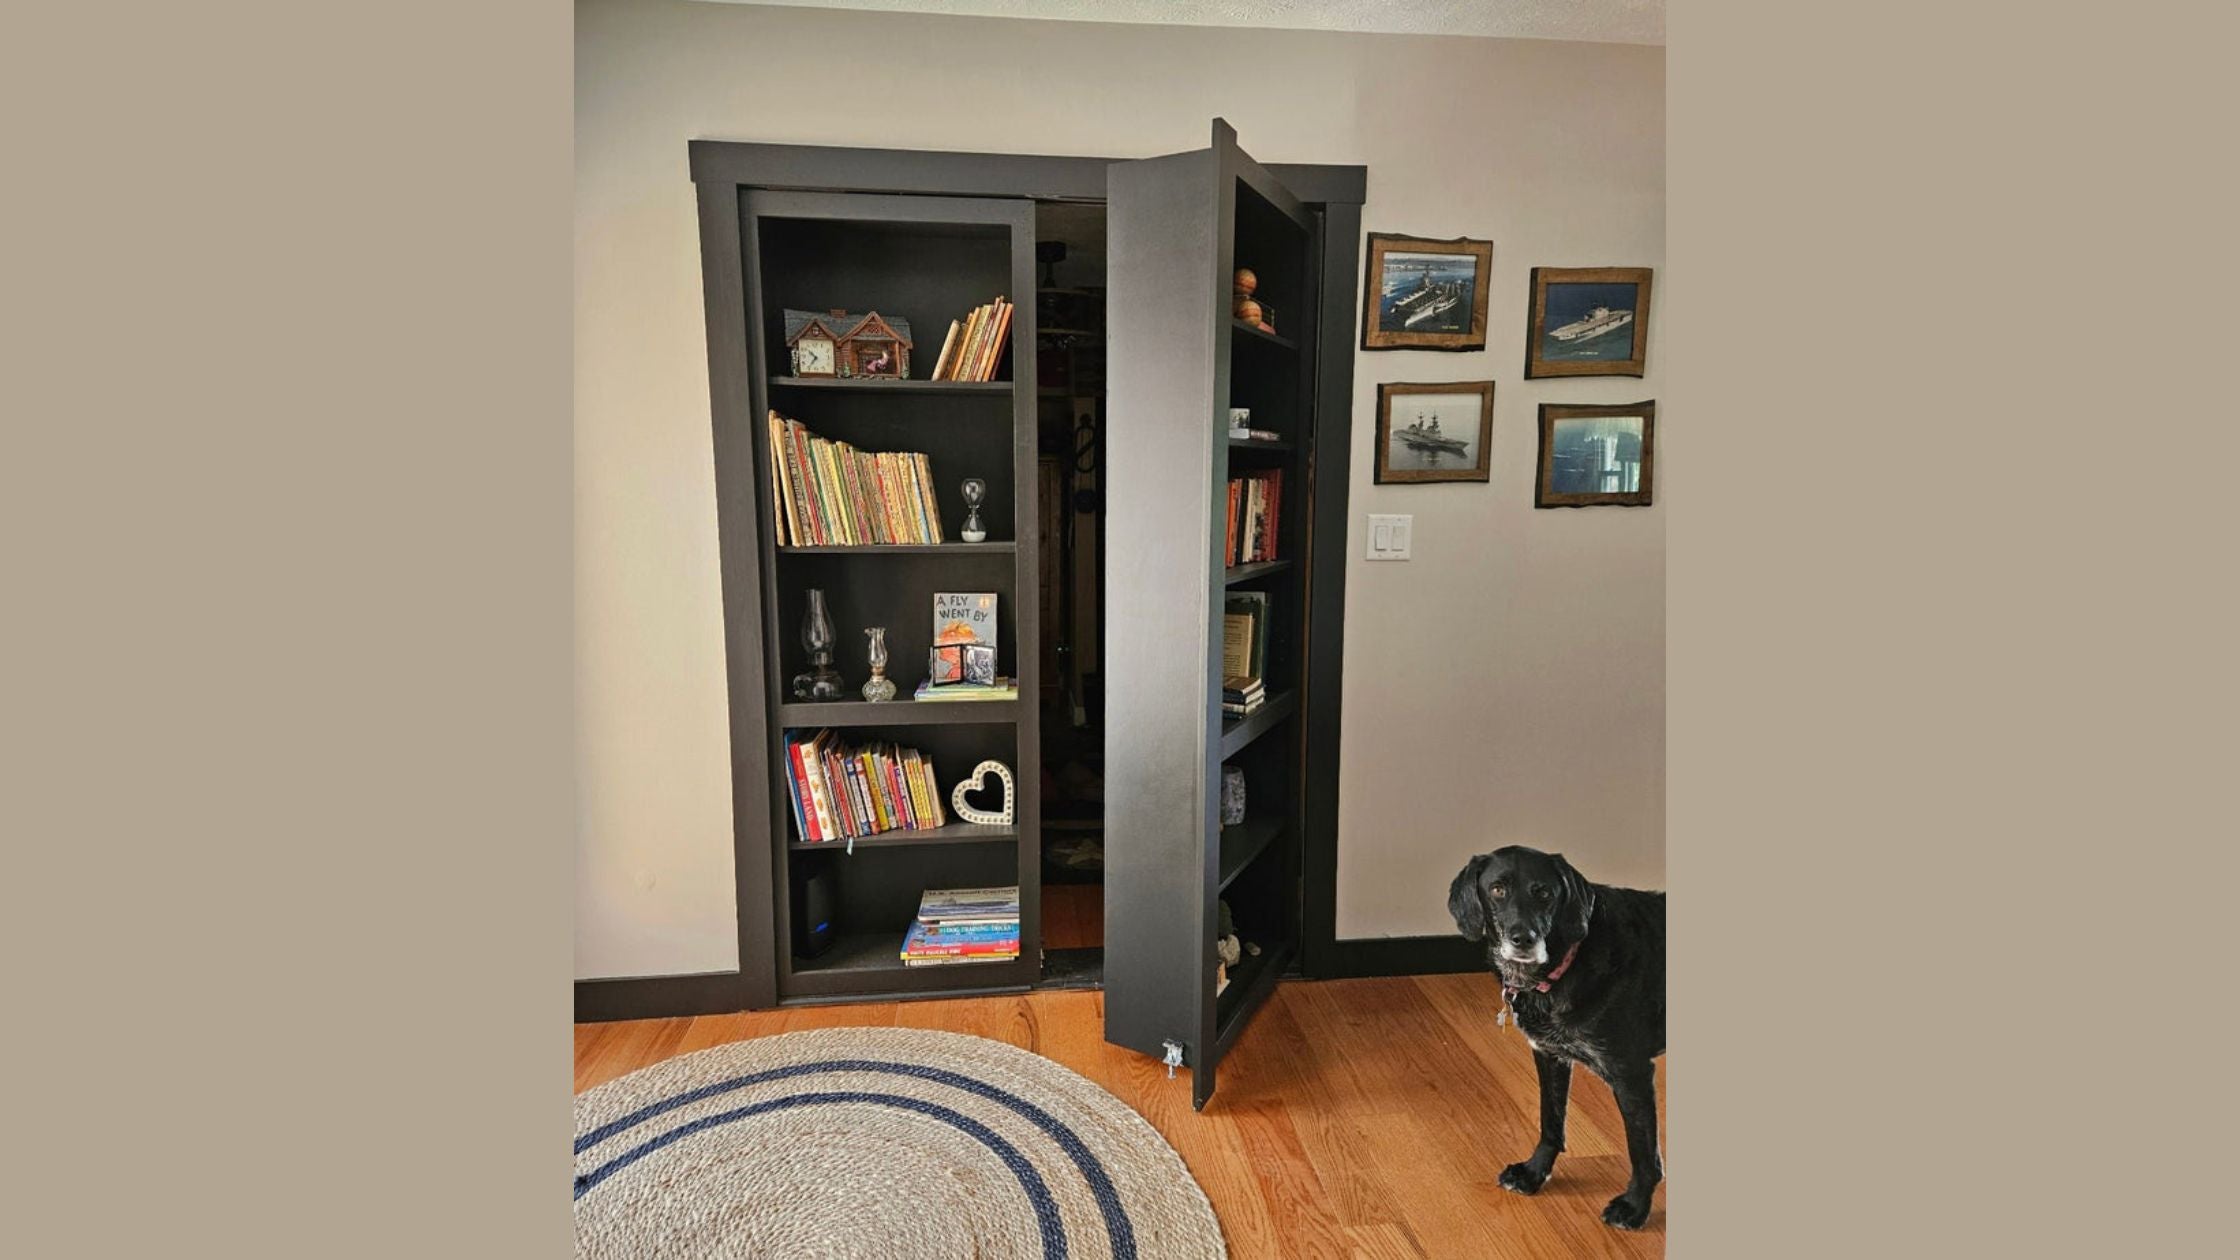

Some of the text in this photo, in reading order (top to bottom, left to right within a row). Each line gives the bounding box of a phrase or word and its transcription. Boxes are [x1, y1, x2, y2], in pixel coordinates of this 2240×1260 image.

[936, 595, 968, 606] A FLY
[939, 609, 988, 622] WENT BY
